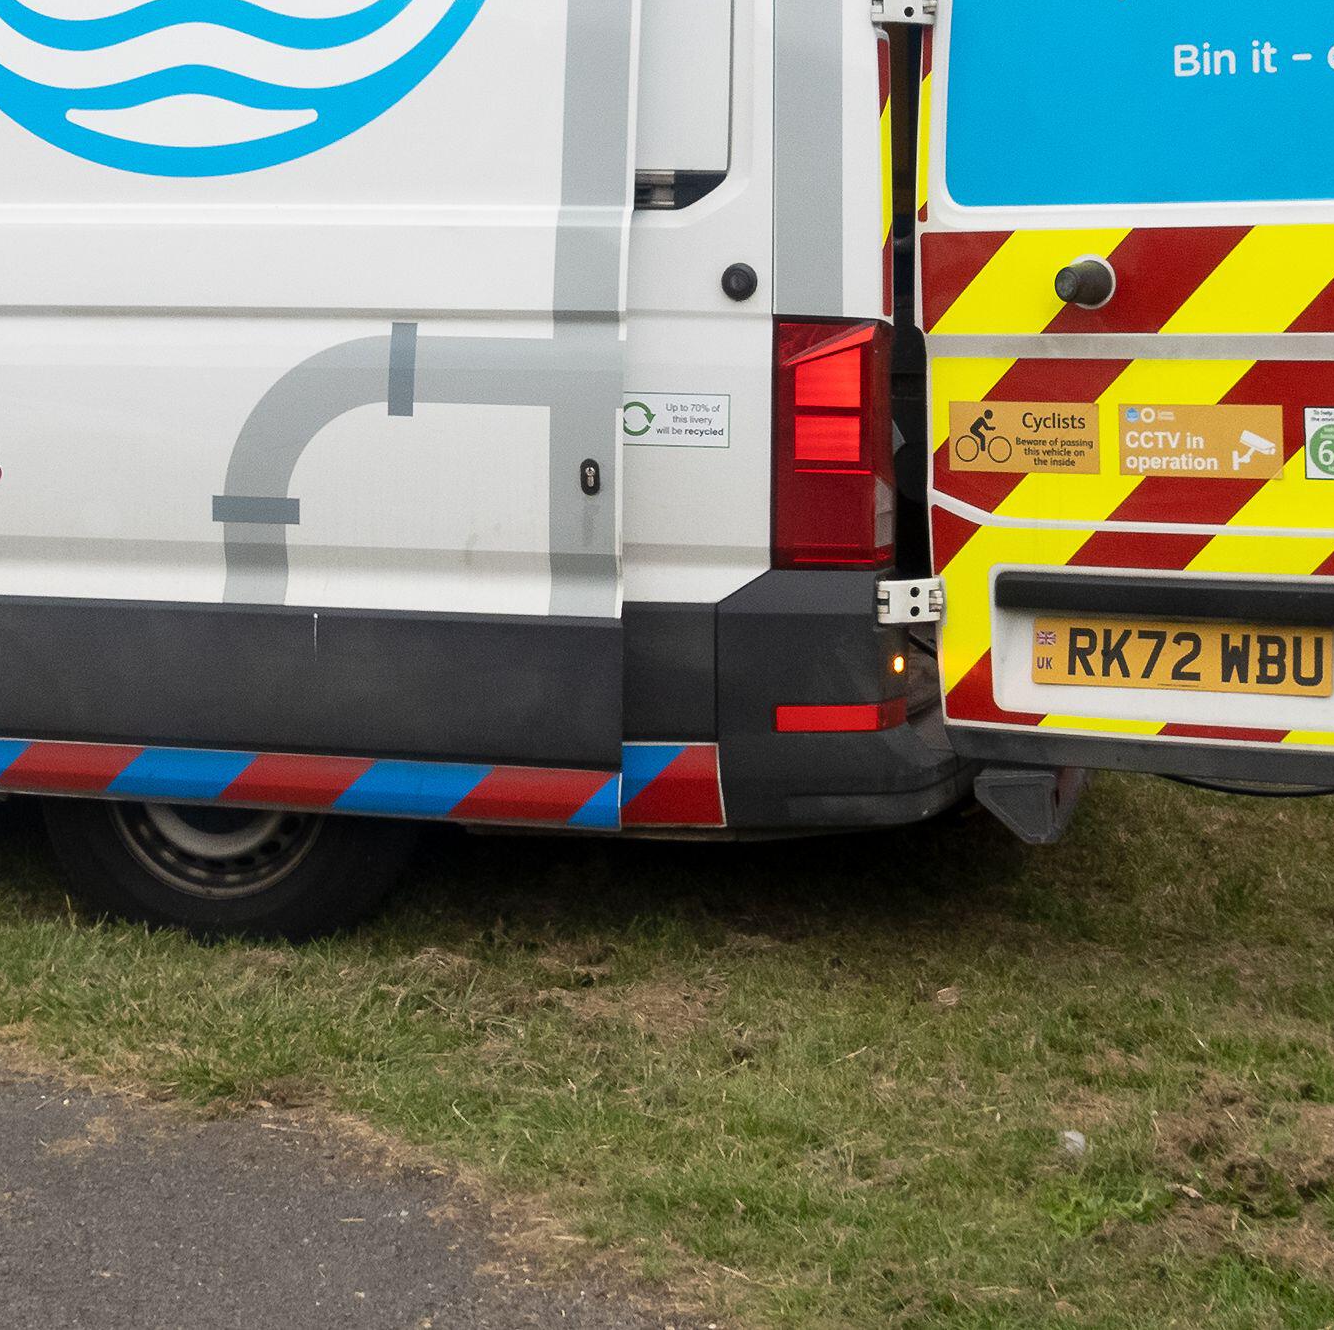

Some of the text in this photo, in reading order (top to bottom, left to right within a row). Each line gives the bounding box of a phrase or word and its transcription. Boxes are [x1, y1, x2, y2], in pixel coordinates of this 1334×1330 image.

[1174, 42, 1236, 77] Bin
[1252, 40, 1277, 74] it
[665, 403, 720, 413] Up to 70% of
[672, 415, 713, 425] this livery
[1022, 412, 1086, 433] Cyclists
[672, 427, 682, 435] be
[684, 428, 724, 437] recycled
[1016, 437, 1093, 449] Beware of passing
[1126, 431, 1204, 449] CCTV in
[1024, 447, 1039, 456] this
[1042, 448, 1071, 456] vehicle
[1034, 457, 1075, 466] the inside
[1126, 455, 1219, 473] operation
[1036, 656, 1053, 670] UK
[1068, 627, 1323, 687] RK72 WBU
